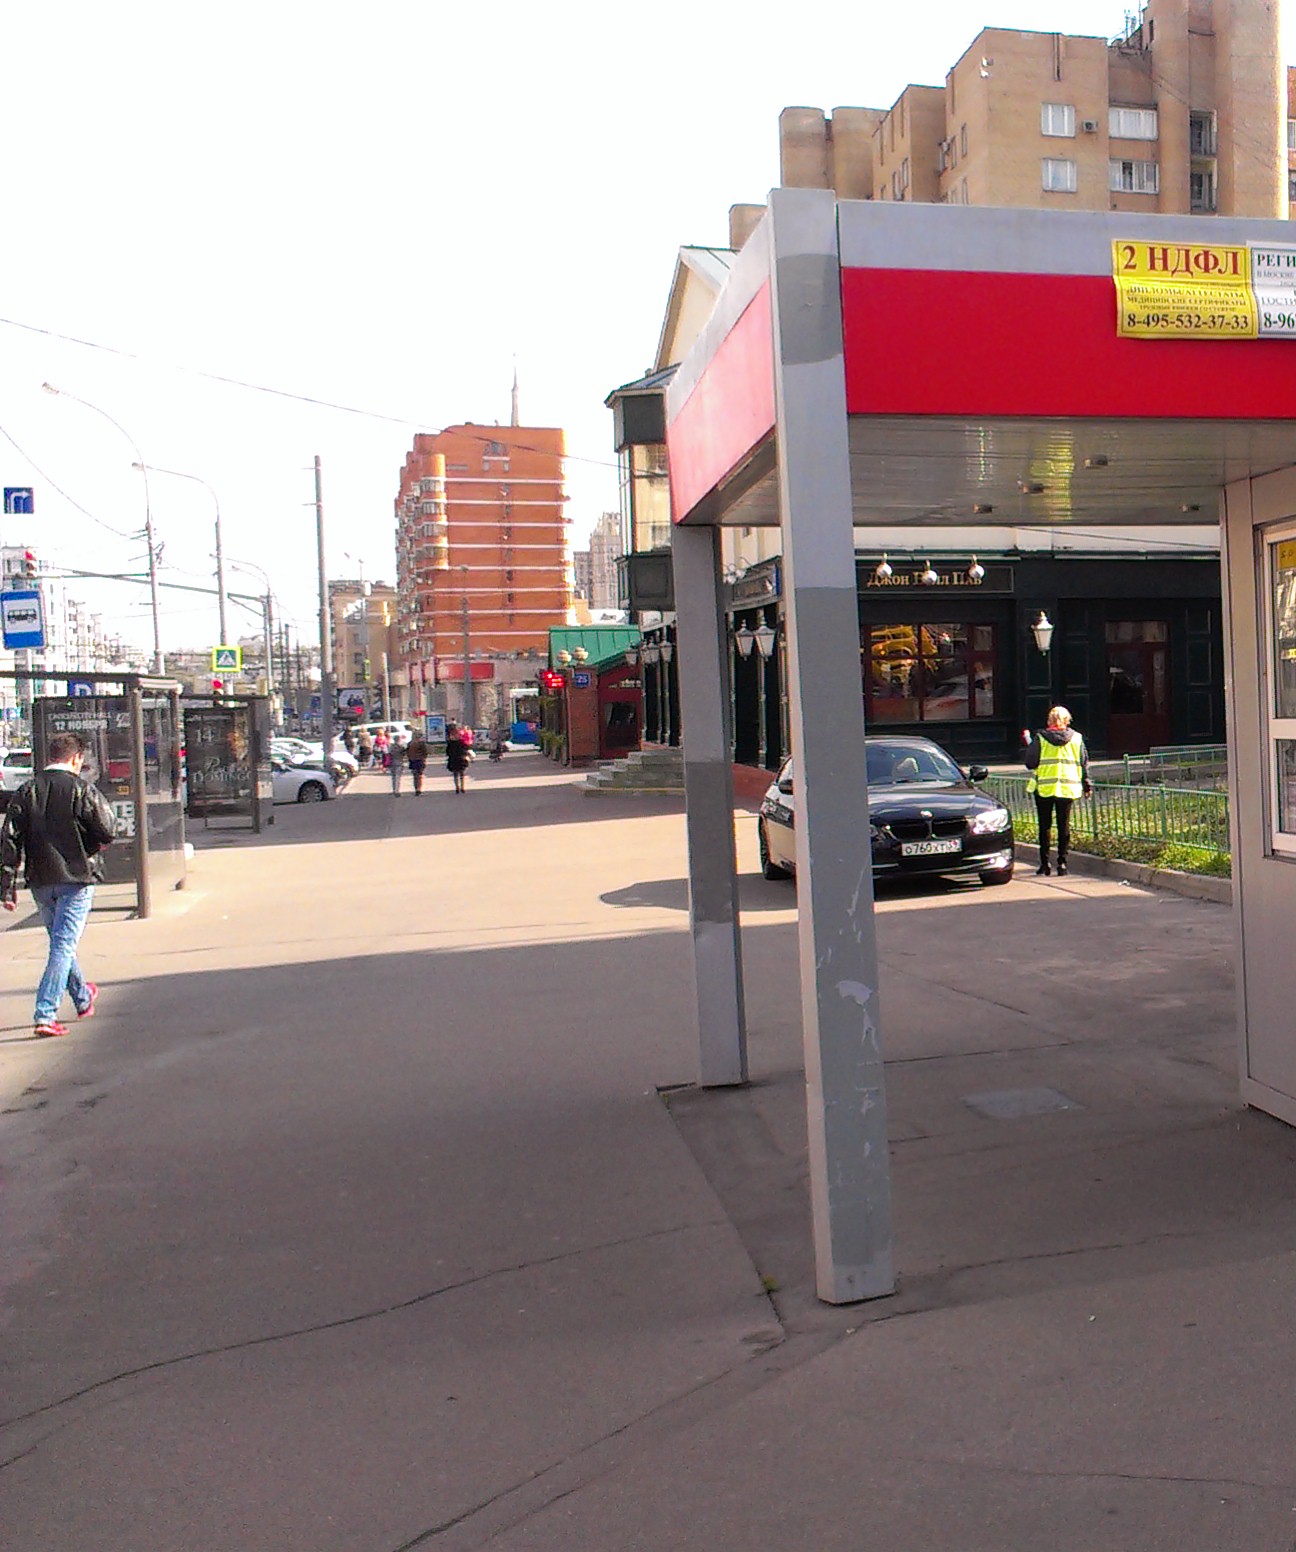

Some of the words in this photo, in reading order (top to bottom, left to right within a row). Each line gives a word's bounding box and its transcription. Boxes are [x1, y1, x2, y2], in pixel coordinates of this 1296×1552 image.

[1123, 245, 1138, 270] 2
[1148, 246, 1241, 279] НДФЛ
[1127, 313, 1249, 330] 8-495-532-37-33
